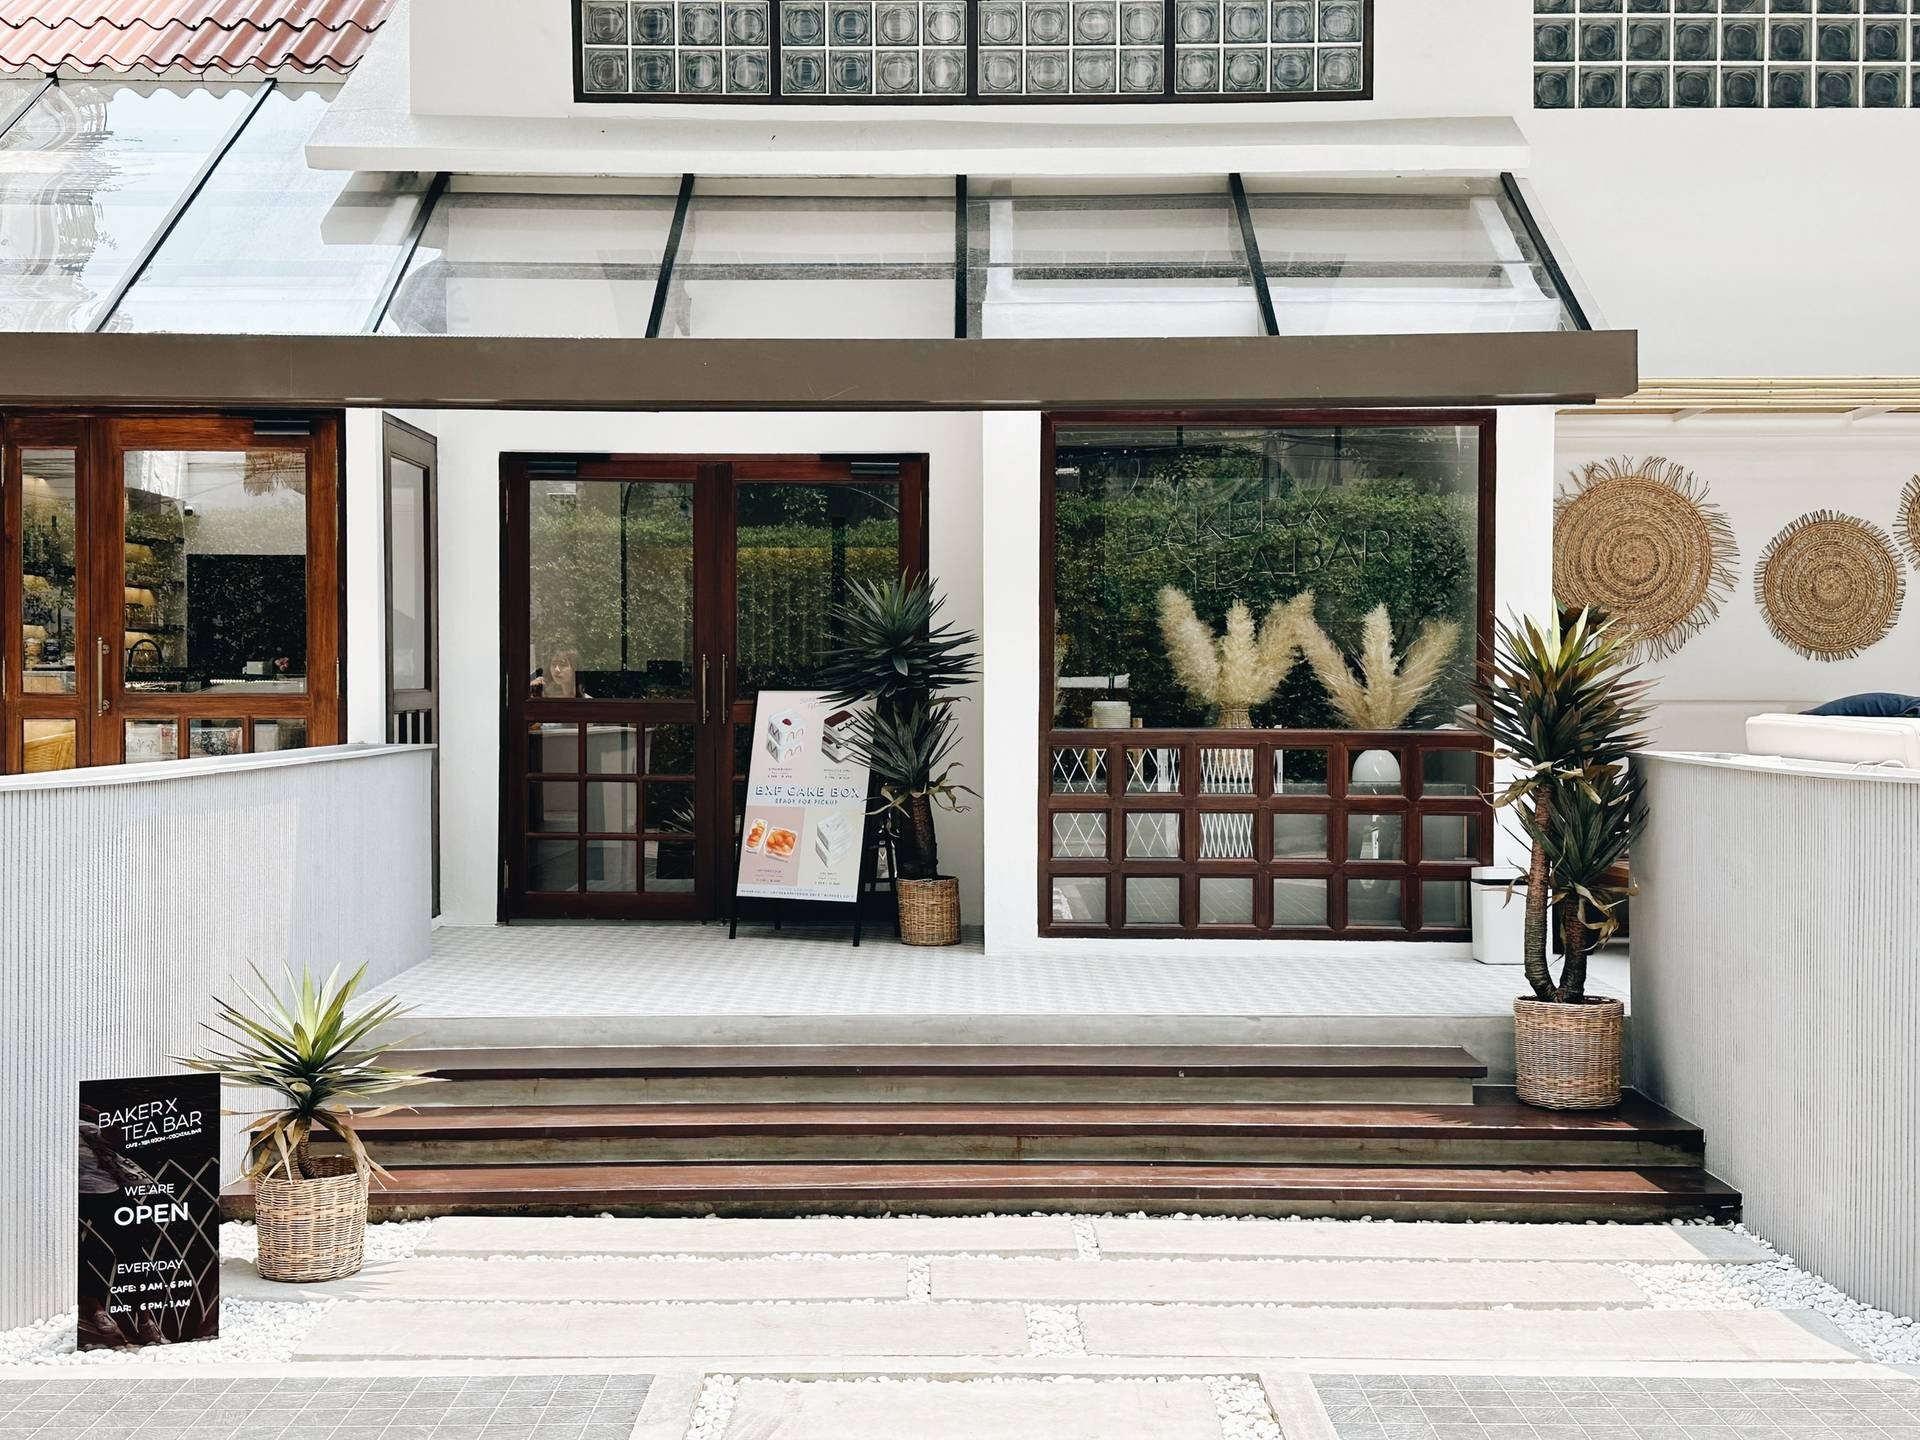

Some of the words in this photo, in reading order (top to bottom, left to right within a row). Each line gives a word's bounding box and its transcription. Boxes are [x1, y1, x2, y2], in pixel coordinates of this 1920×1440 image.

[787, 786, 825, 797] CAKE
[830, 787, 860, 799] BOX
[775, 797, 796, 805] READY
[121, 1121, 159, 1142] TEA
[163, 1110, 203, 1134] BAR
[151, 1135, 166, 1144] ROOM
[124, 1185, 146, 1197] WE
[148, 1183, 175, 1195] ARE
[113, 1201, 189, 1227] OPEN
[117, 1258, 184, 1275] EVERYDAY
[110, 1285, 137, 1294] CAFE:
[139, 1283, 146, 1292] 9
[147, 1282, 163, 1291] AM
[170, 1280, 177, 1289] 6
[178, 1279, 192, 1288] PM
[110, 1304, 132, 1313] BAR:
[140, 1302, 147, 1311] 6
[148, 1301, 163, 1310] PM
[175, 1299, 191, 1308] AM
